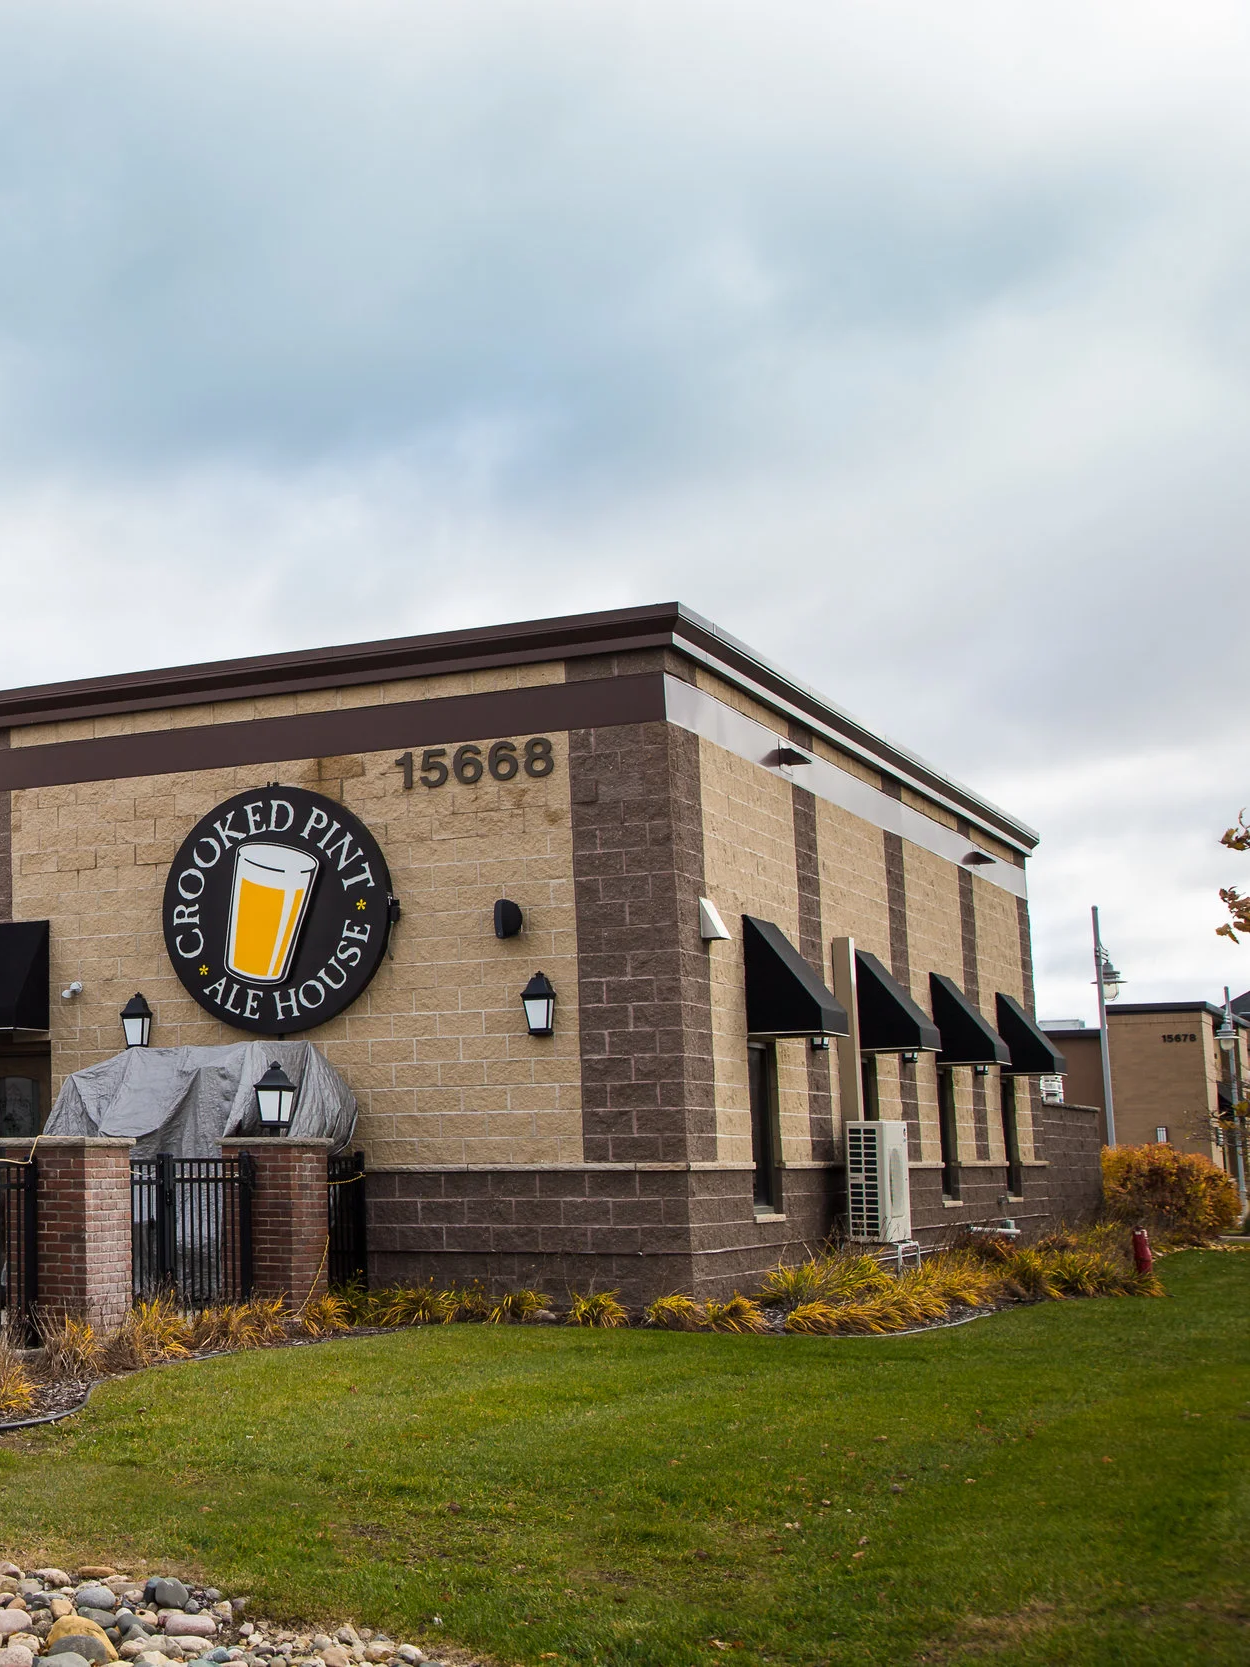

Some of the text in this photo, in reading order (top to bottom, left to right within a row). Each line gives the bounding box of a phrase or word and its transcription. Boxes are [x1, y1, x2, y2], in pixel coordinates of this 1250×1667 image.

[394, 737, 555, 789] 15668
[173, 799, 375, 959] CROOKED PINT
[203, 919, 371, 1020] ALE HOUSE
[1161, 1033, 1197, 1043] 15678
